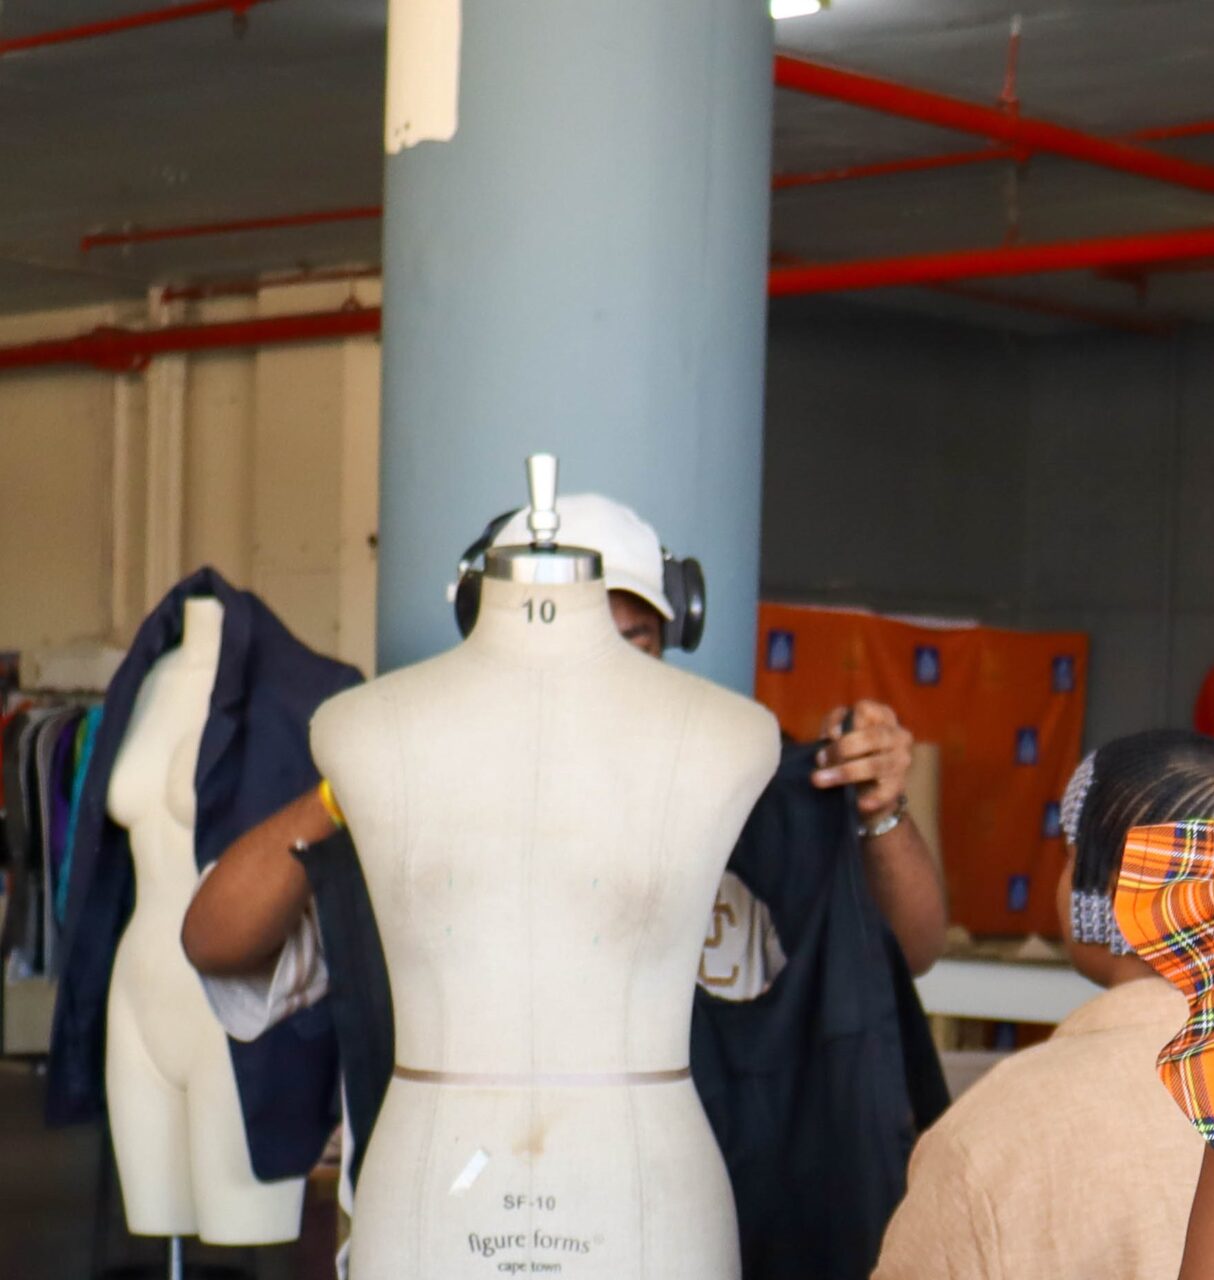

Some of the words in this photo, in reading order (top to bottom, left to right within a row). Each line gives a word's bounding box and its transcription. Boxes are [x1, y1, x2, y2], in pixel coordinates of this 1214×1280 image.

[521, 597, 556, 624] 10
[503, 1194, 556, 1211] SF-10
[468, 1232, 526, 1257] figure
[533, 1229, 591, 1254] forms
[498, 1262, 527, 1275] cape
[531, 1261, 562, 1273] town
